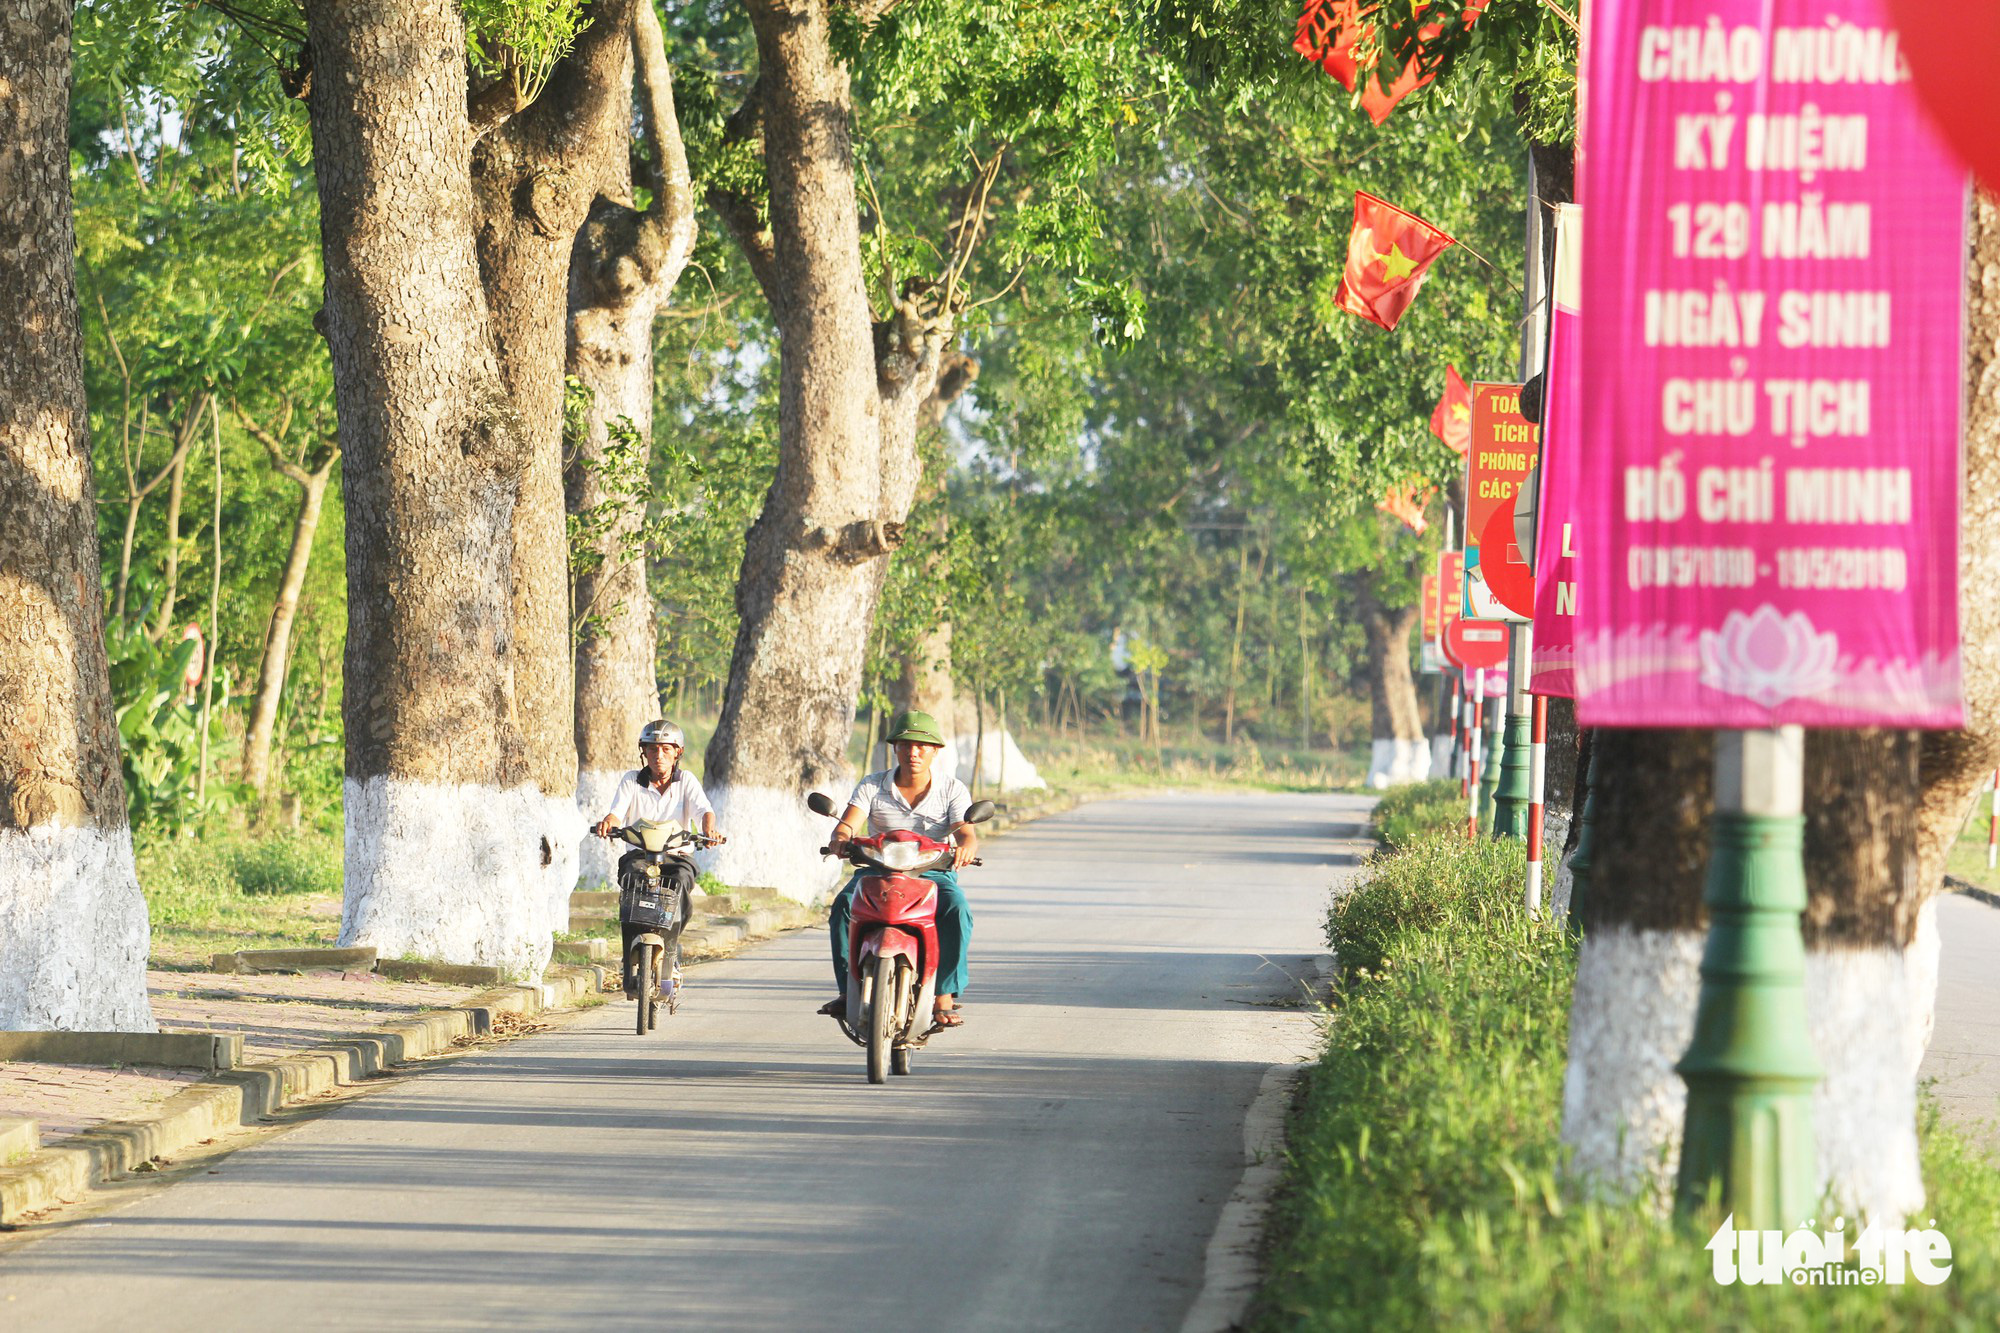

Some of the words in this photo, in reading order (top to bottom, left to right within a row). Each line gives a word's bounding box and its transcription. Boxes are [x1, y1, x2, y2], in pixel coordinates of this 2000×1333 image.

[1638, 14, 1762, 84] CHÀO
[1674, 91, 1736, 171] KỶ
[1745, 102, 1868, 183] NIỆM
[1667, 202, 1750, 260] 129
[1762, 192, 1871, 260] NĂM
[1645, 277, 1766, 347] NGÀY
[1778, 290, 1891, 348] SINH
[1490, 393, 1520, 414] TOÀ
[1493, 421, 1528, 442] TÍCH
[1662, 356, 1755, 436] CHỦ
[1765, 379, 1871, 448] TỊCH
[1479, 449, 1526, 471] PHÒNG
[1479, 478, 1511, 499] CÁC
[1697, 456, 1774, 523] CHÍ
[1786, 468, 1911, 524] MINH
